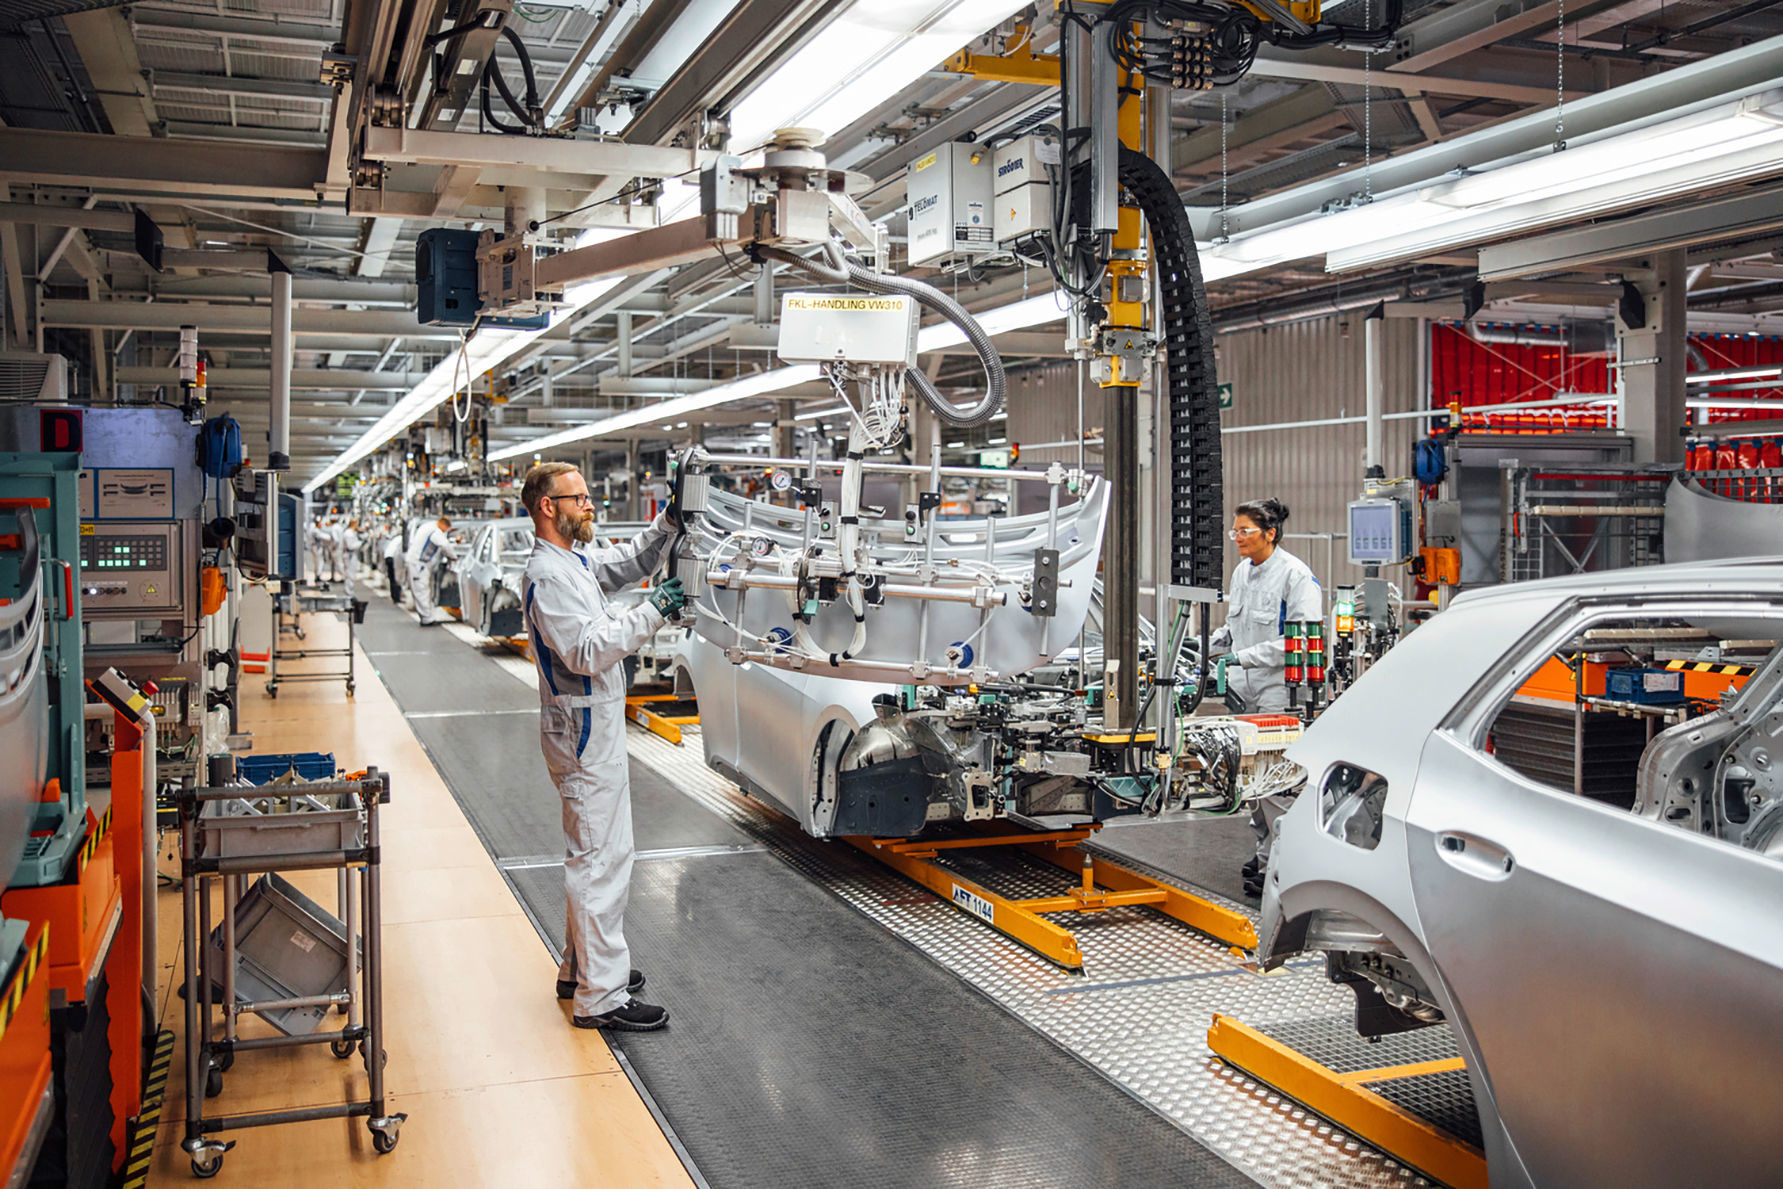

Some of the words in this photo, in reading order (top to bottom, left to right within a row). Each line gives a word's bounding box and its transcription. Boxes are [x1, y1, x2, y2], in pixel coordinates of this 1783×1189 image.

[788, 299, 866, 310] FKL-HANDLING
[868, 300, 903, 310] VW310
[43, 412, 82, 452] D
[973, 897, 993, 920] 1144
